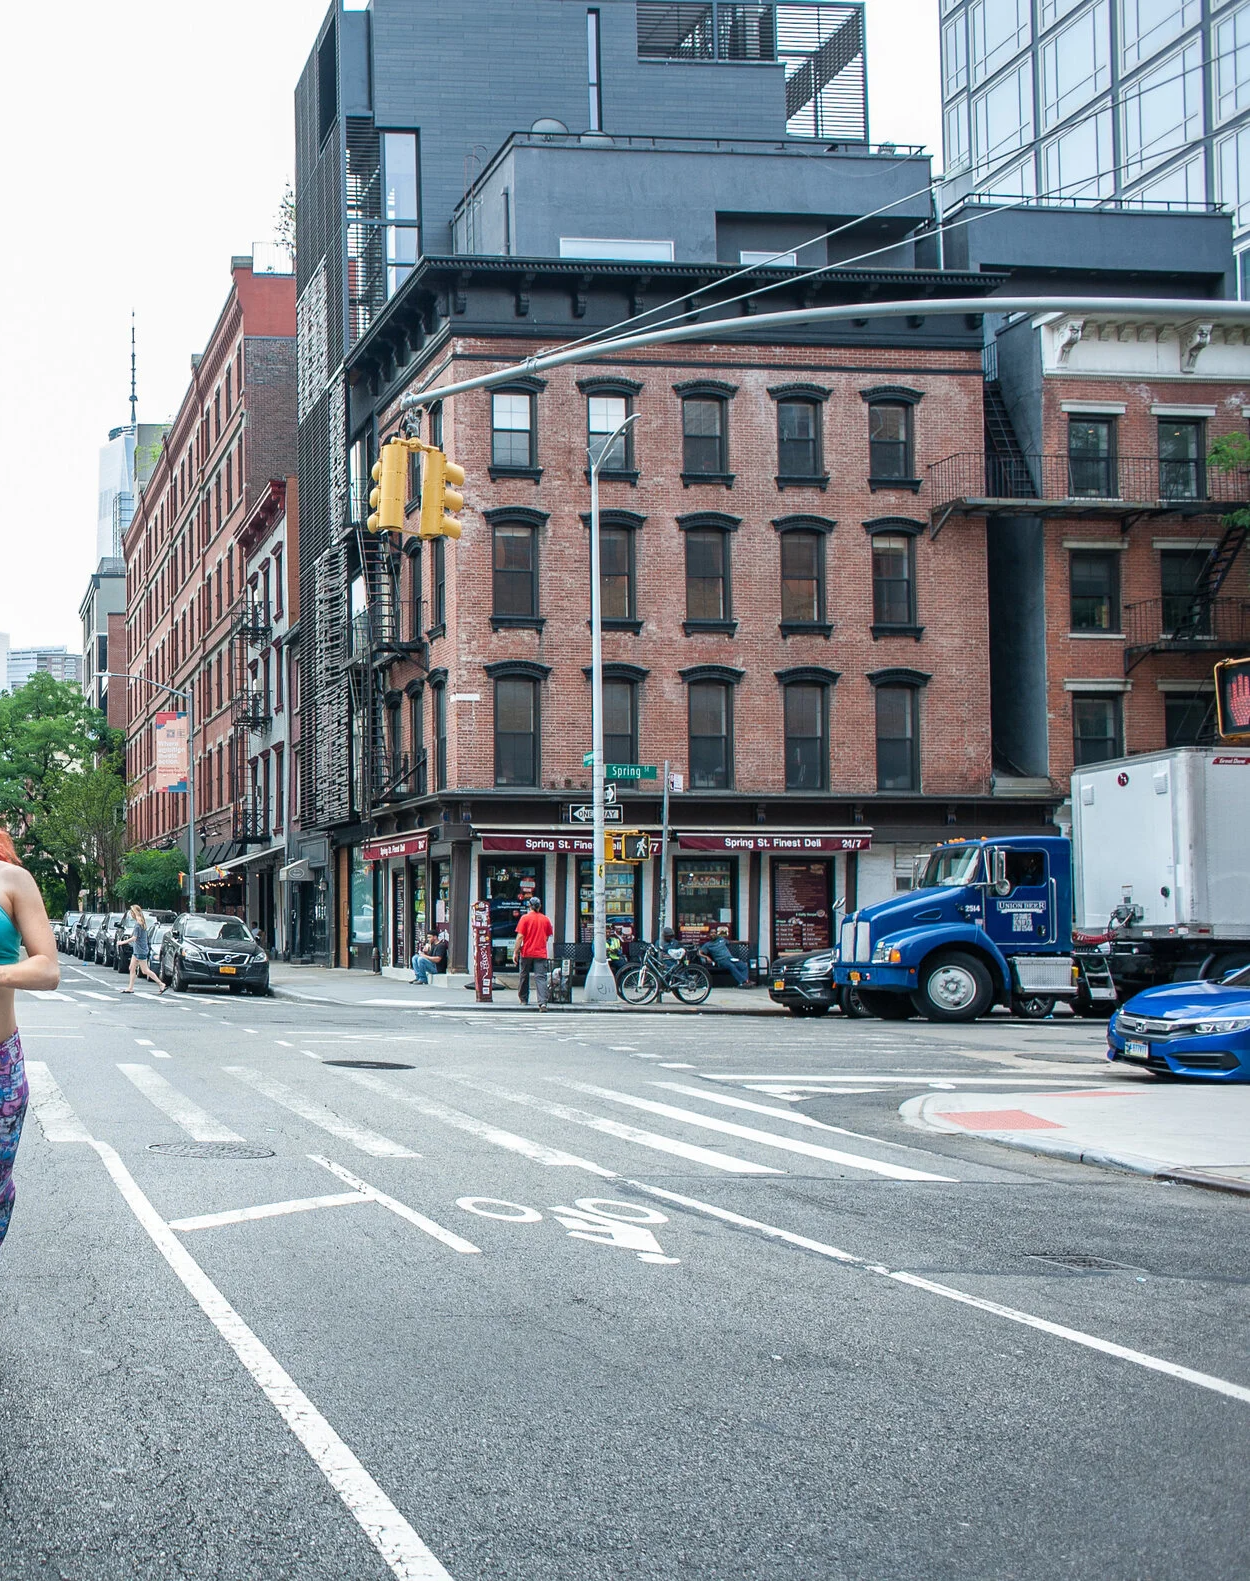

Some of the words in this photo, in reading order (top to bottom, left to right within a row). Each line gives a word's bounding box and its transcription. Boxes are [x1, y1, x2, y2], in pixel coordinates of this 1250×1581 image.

[612, 766, 641, 779] Spring
[578, 810, 594, 818] ONE
[525, 839, 555, 850] Spring
[558, 840, 570, 849] St.
[574, 840, 594, 850] Fine
[725, 838, 753, 848] Spring
[757, 838, 770, 847] St.
[773, 838, 801, 847] Finest
[804, 838, 821, 847] Deli
[841, 839, 861, 849] 24/7
[964, 904, 981, 912] 2514
